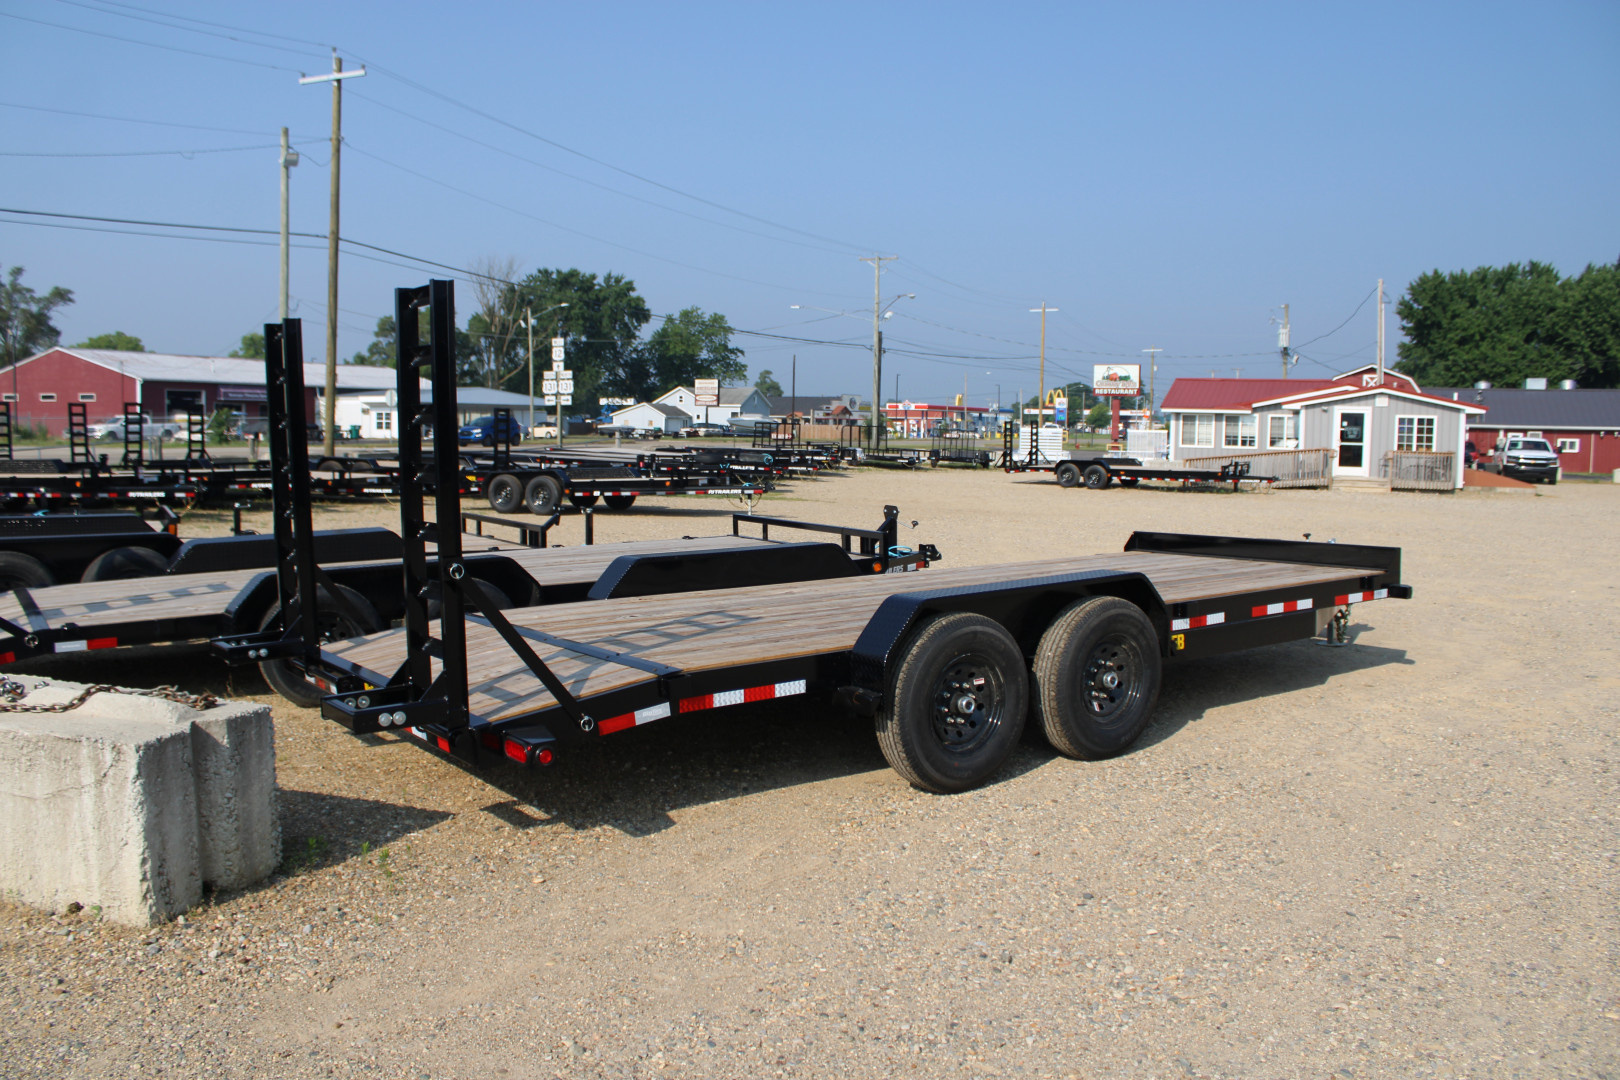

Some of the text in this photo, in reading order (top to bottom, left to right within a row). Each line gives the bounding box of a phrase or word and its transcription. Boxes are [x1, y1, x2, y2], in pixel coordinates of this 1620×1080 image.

[554, 350, 563, 358] 12
[544, 383, 556, 392] 131
[560, 383, 572, 392] 131
